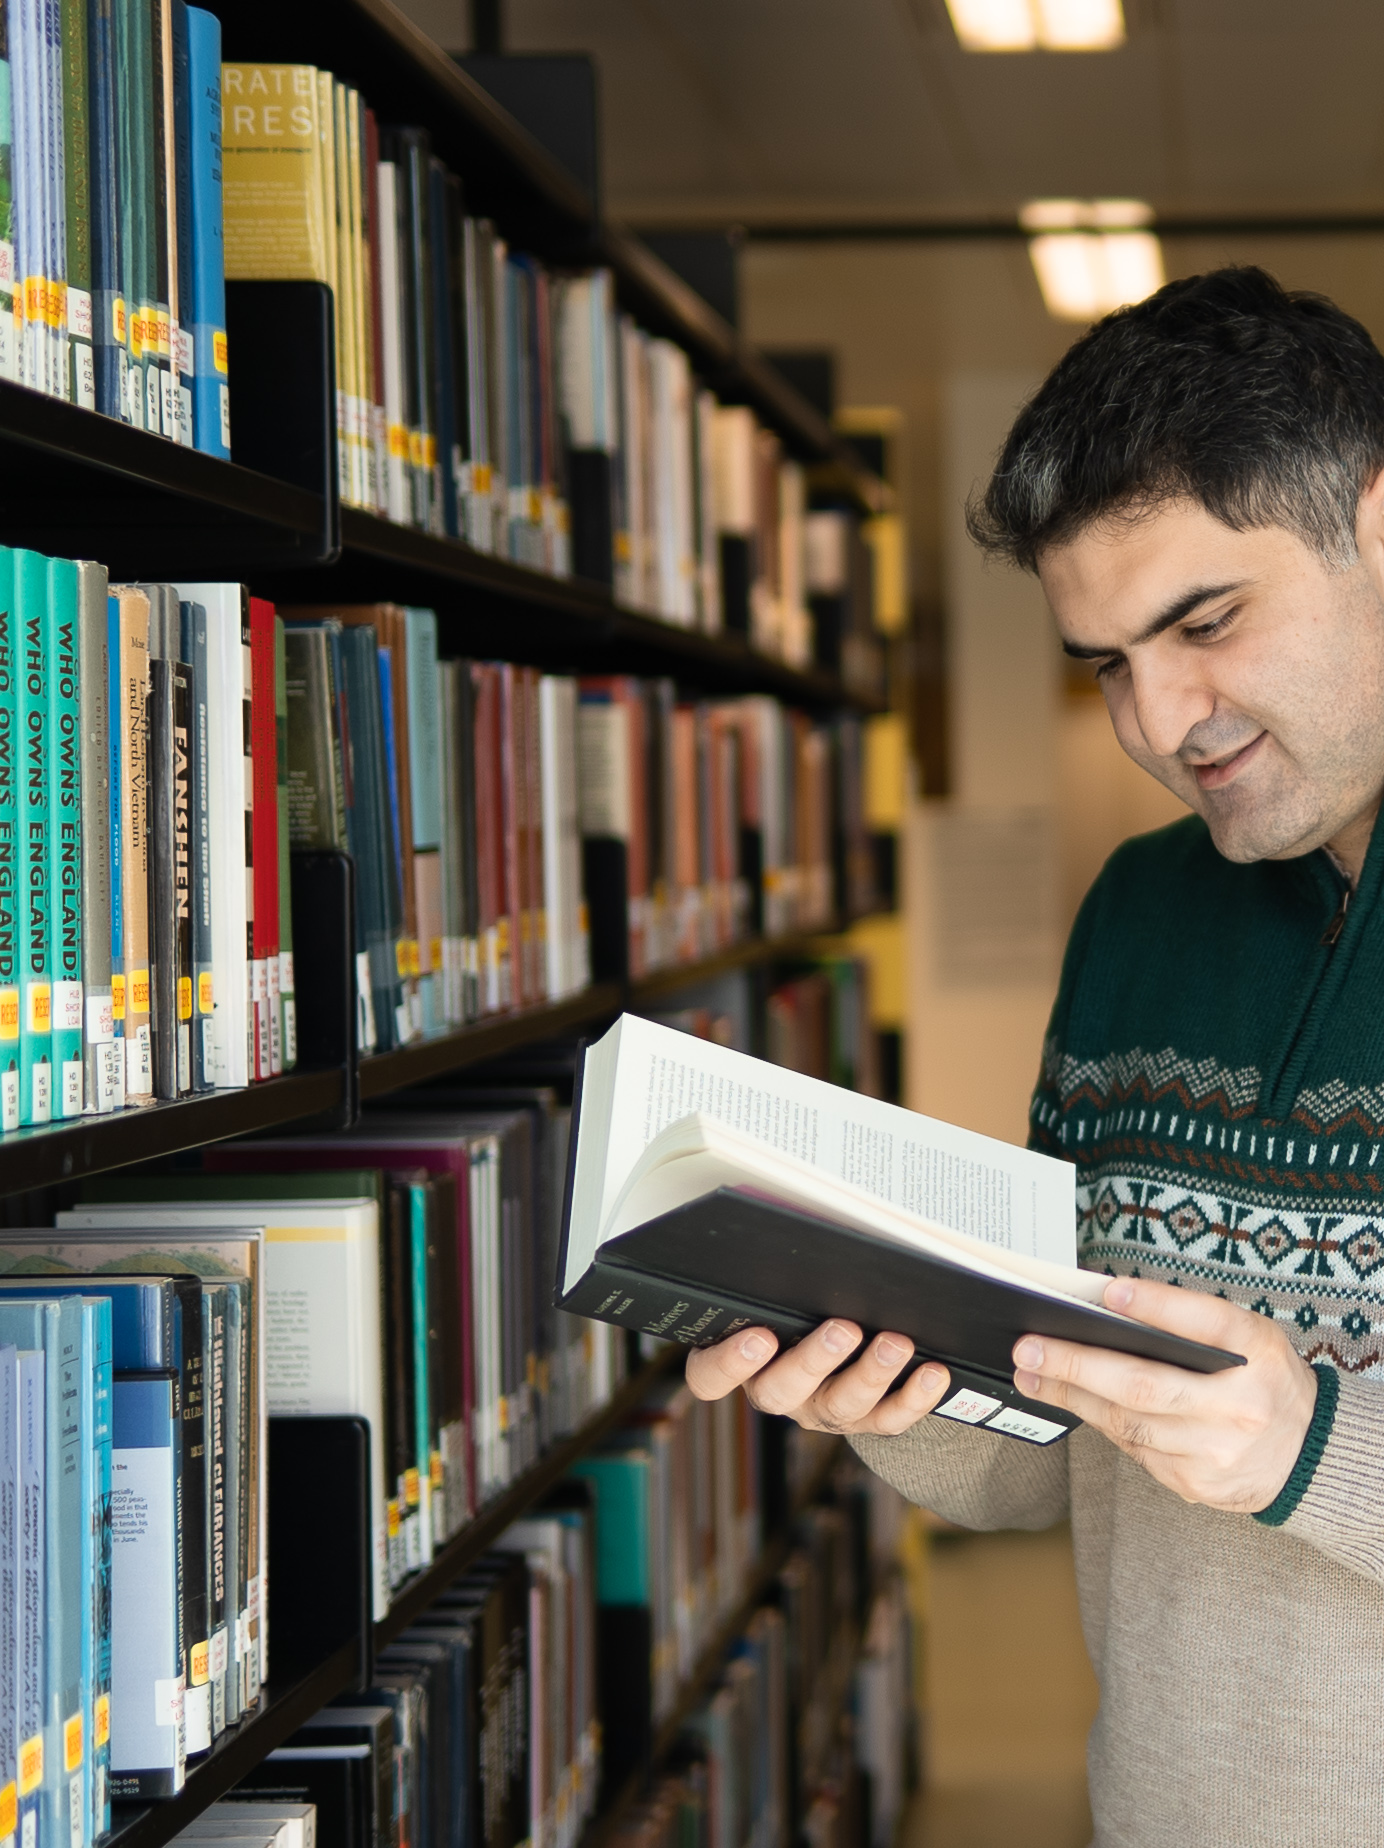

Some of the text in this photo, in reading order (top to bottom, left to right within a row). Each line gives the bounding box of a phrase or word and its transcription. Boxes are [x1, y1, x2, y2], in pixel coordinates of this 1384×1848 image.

[221, 105, 313, 136] RES
[26, 616, 42, 696] WHO
[27, 710, 43, 806] OWNS
[129, 677, 142, 848] and North Vietnam
[199, 702, 207, 812] Resistance
[59, 622, 77, 982] WHO OWNS ENGLAND?
[174, 727, 189, 918] FANSHEN
[201, 817, 208, 838] to
[641, 1299, 691, 1335] Motives
[680, 1305, 725, 1338] Honor,
[213, 1338, 224, 1601] Highland CLEARANCES
[23, 1484, 31, 1540] society
[23, 1615, 31, 1680] century
